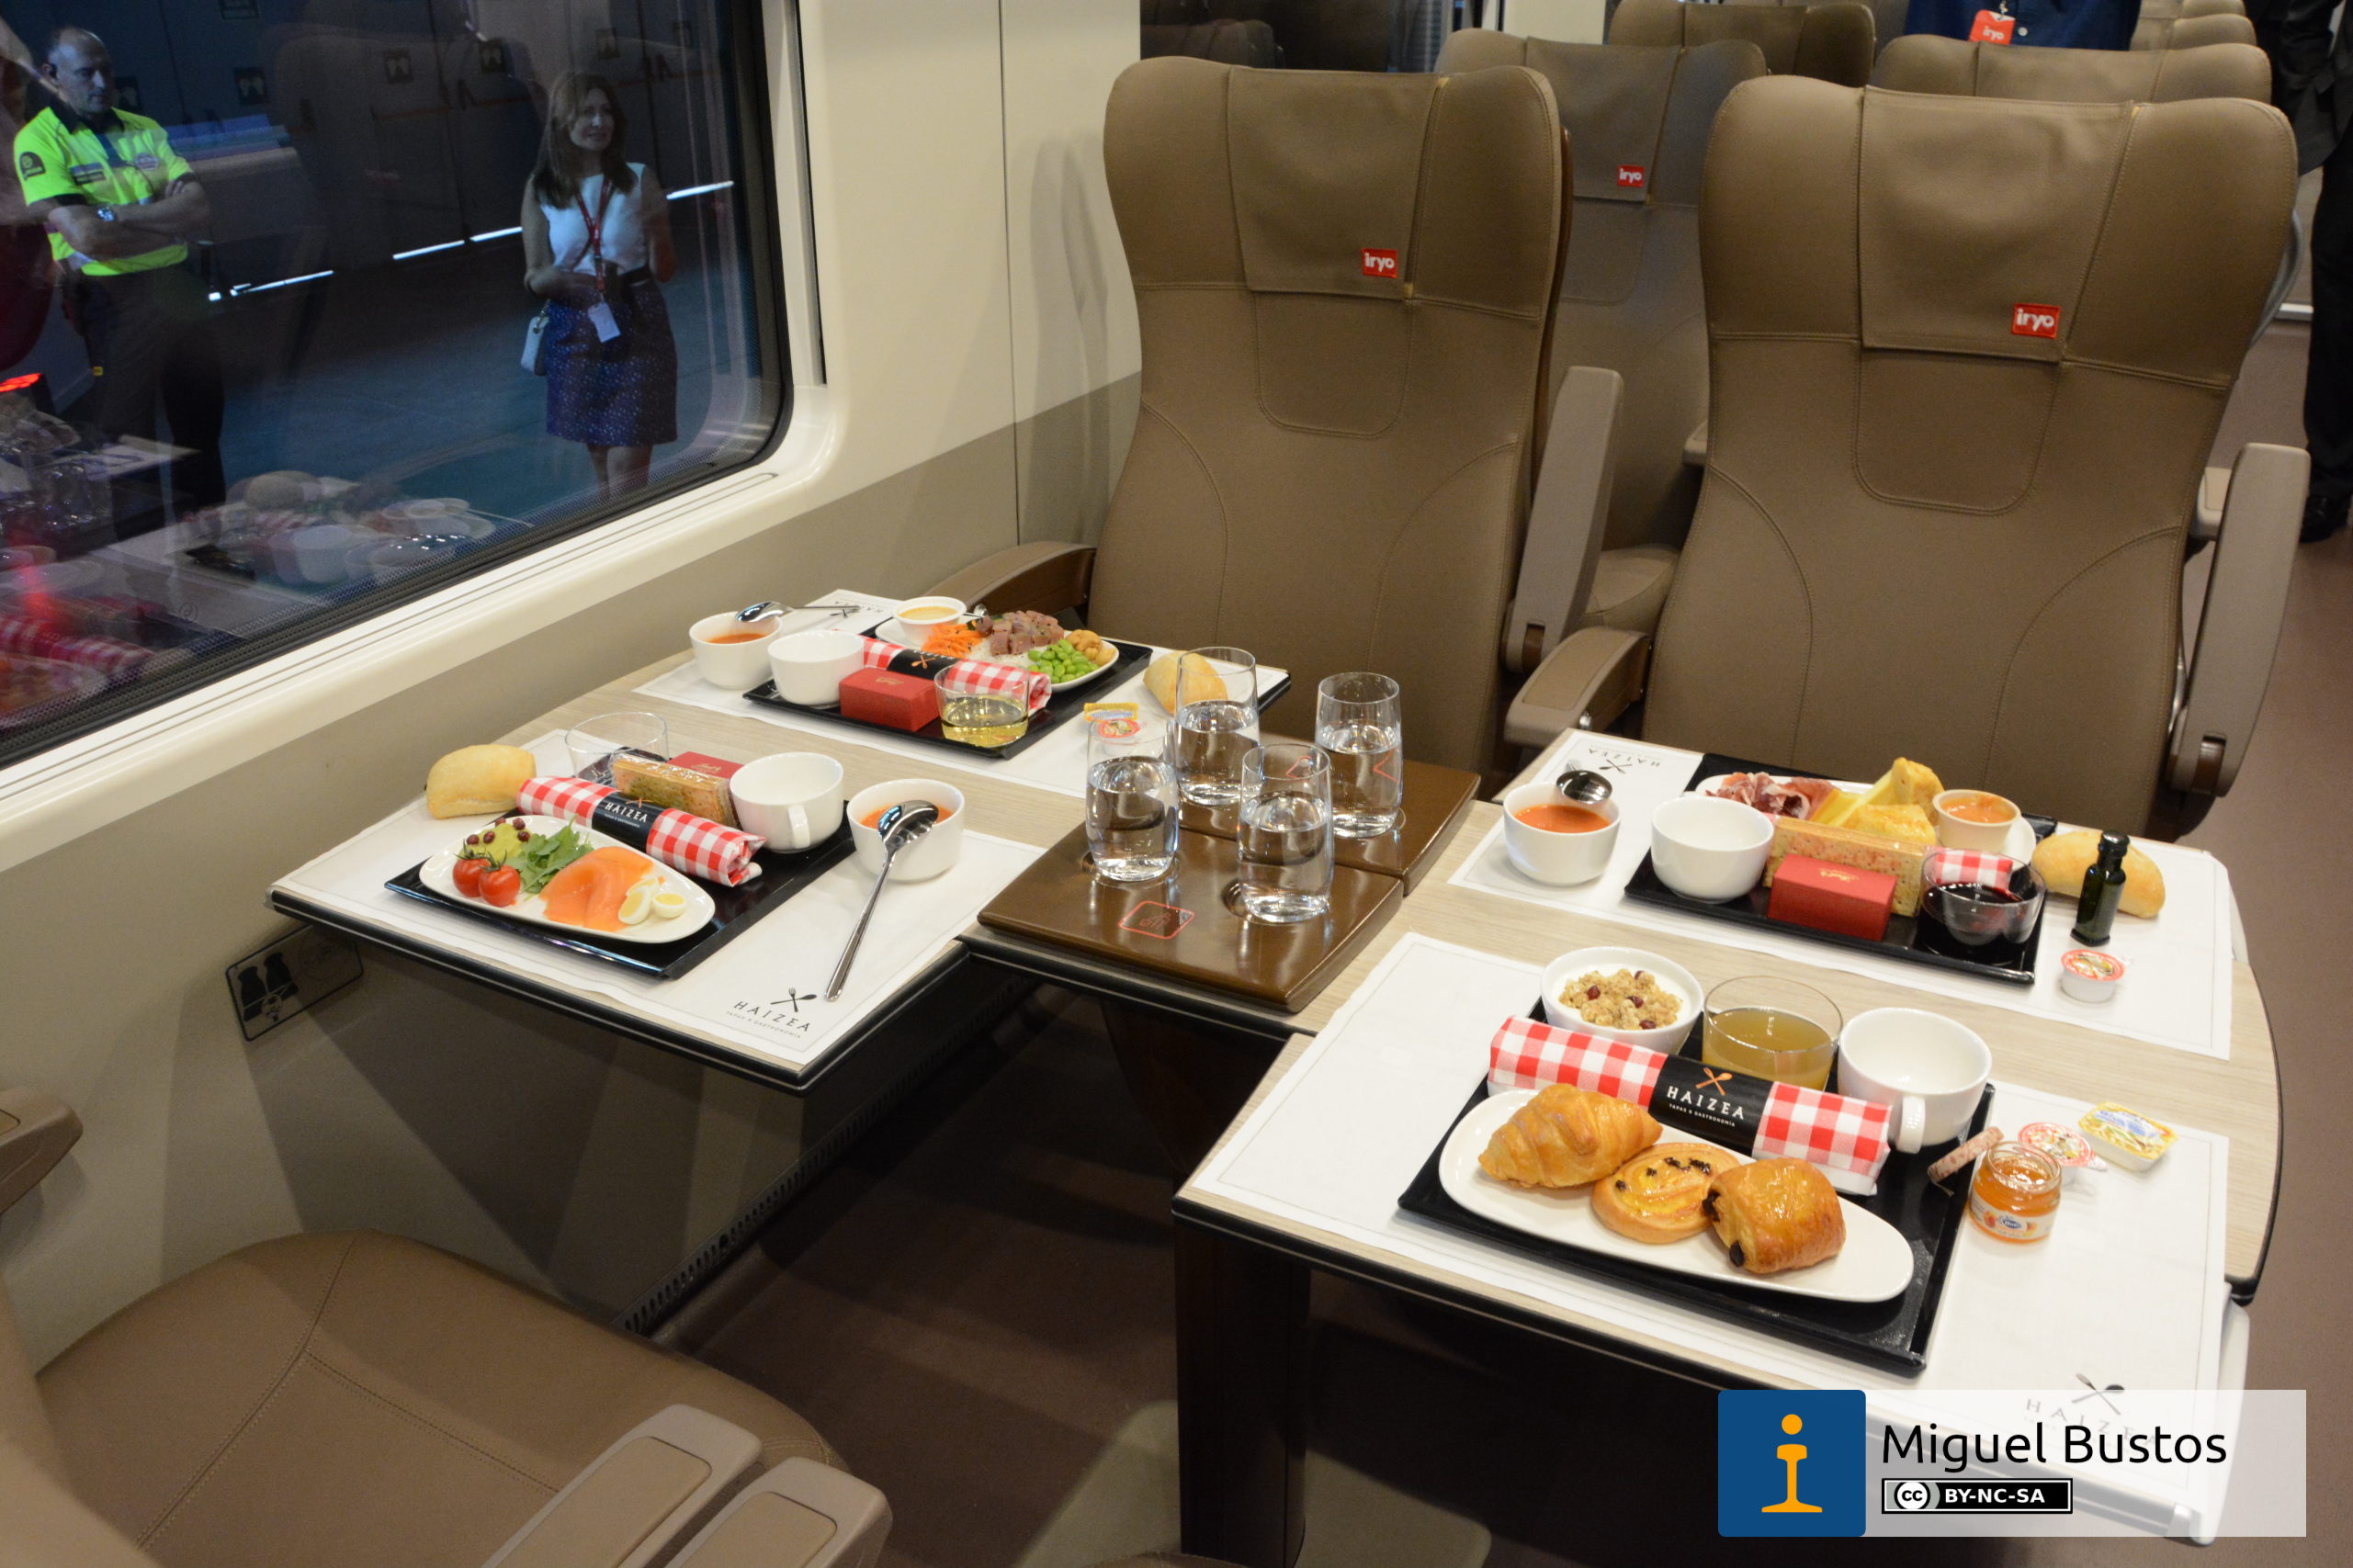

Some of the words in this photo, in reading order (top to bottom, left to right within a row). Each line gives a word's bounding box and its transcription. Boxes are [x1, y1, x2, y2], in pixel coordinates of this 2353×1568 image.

[1620, 168, 1642, 184] iryo
[1364, 252, 1395, 273] iryo
[2017, 308, 2055, 332] iryo
[605, 802, 648, 823] HAIZEA
[733, 1000, 810, 1032] HAIZEA
[1667, 1085, 1744, 1120] HAIZEA
